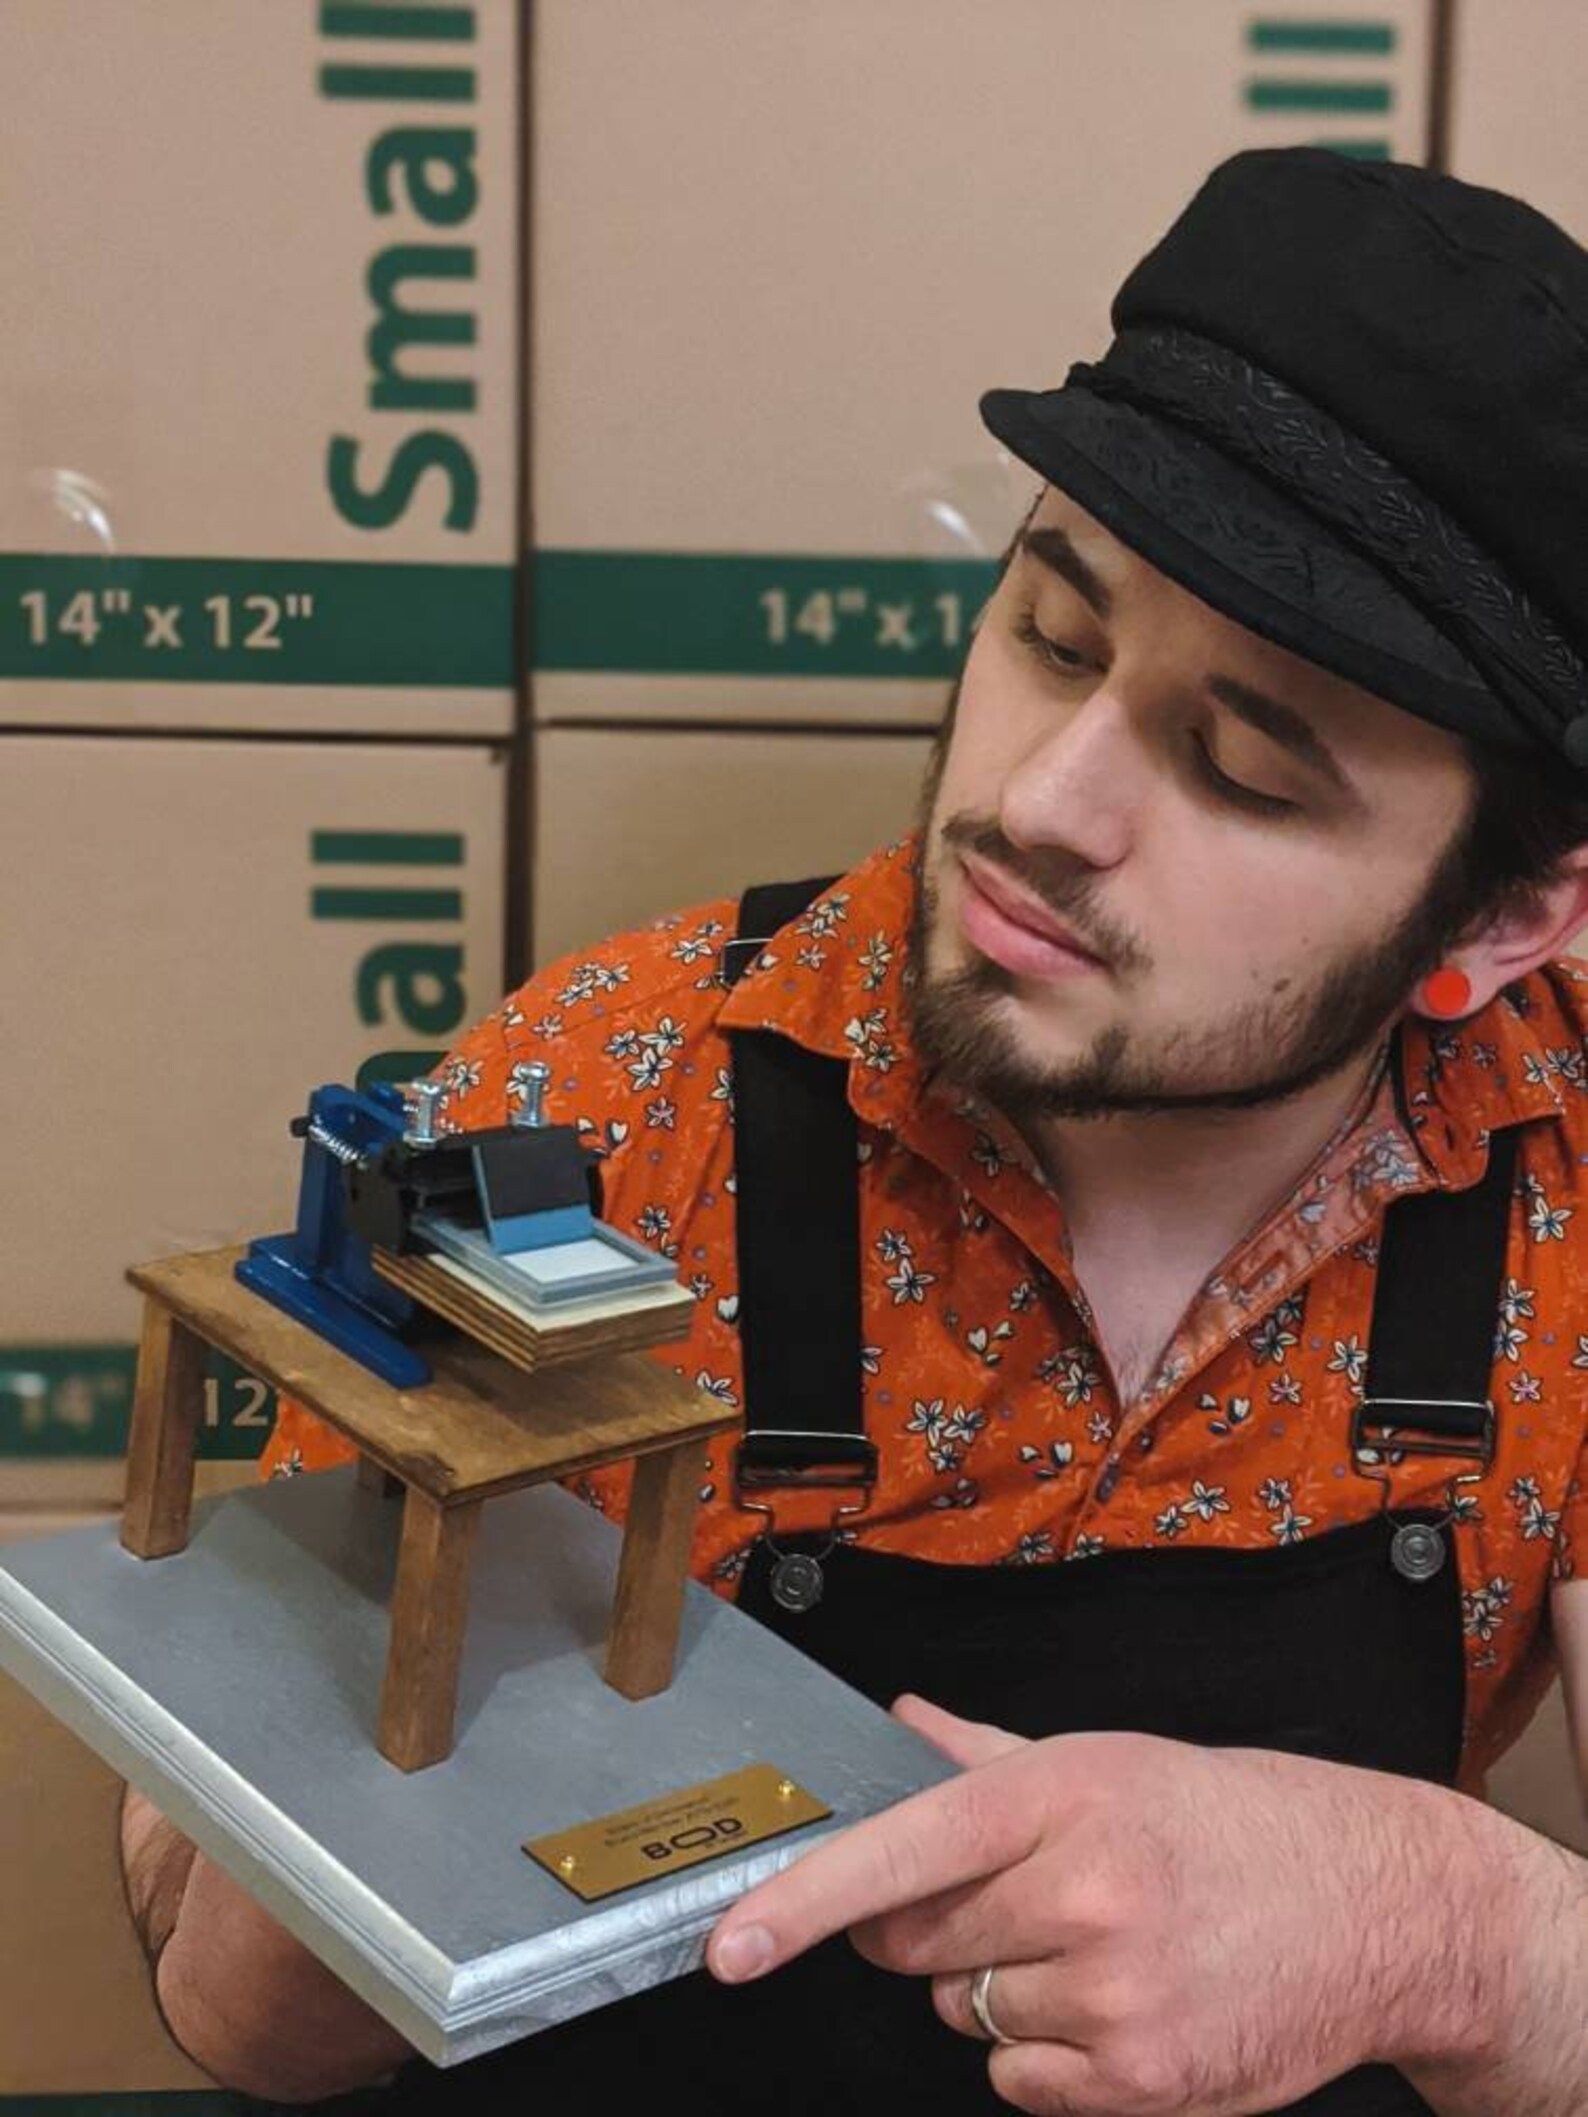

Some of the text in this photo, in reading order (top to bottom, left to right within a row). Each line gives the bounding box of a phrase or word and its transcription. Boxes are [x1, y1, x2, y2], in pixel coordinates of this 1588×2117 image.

[1245, 22, 1393, 162] ll
[317, 2, 480, 534] Small
[20, 590, 313, 649] 14" x 12"
[760, 588, 983, 649] 14" x 1
[203, 1378, 281, 1427] 12
[641, 1818, 743, 1860] BOD
